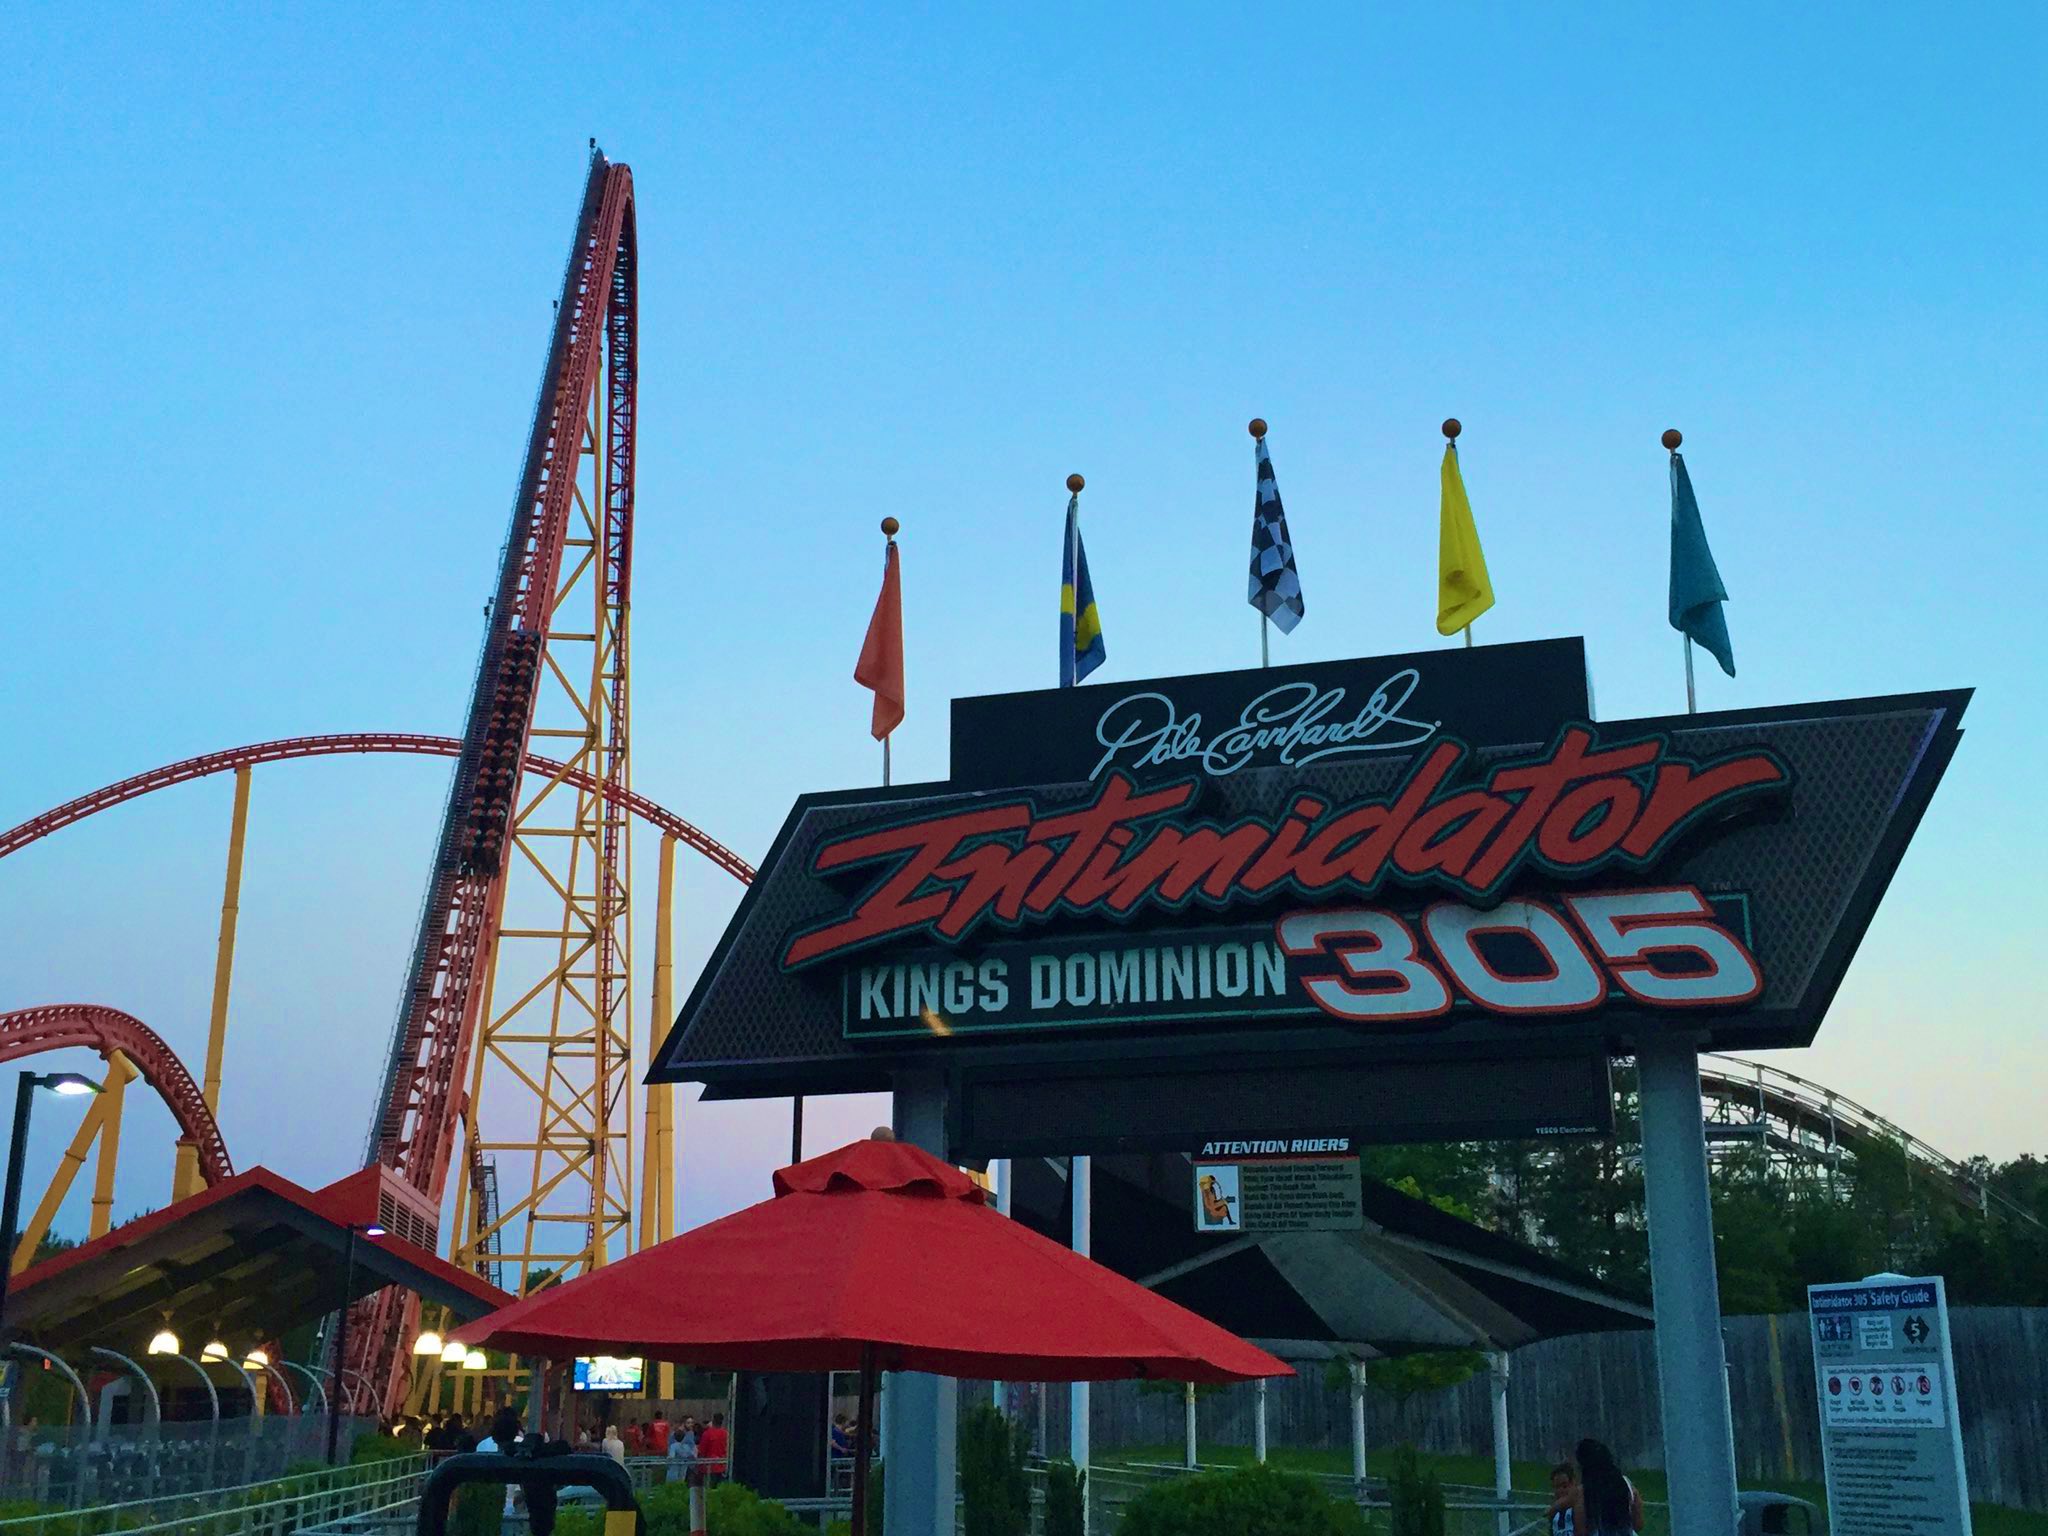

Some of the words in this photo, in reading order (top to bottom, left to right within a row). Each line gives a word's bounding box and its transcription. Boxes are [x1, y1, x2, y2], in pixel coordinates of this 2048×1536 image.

[784, 730, 1780, 966] Intimidator
[860, 959, 1009, 1020] KINGS
[1030, 941, 1287, 1010] DOMINION
[1276, 884, 1763, 1021] 305
[1201, 1140, 1288, 1155] ATTENTION
[1290, 1138, 1350, 1151] RIDERS
[1853, 1293, 1868, 1306] 305
[1870, 1291, 1900, 1308] Safety
[1901, 1289, 1930, 1304] Guide
[1910, 1322, 1920, 1337] 5
